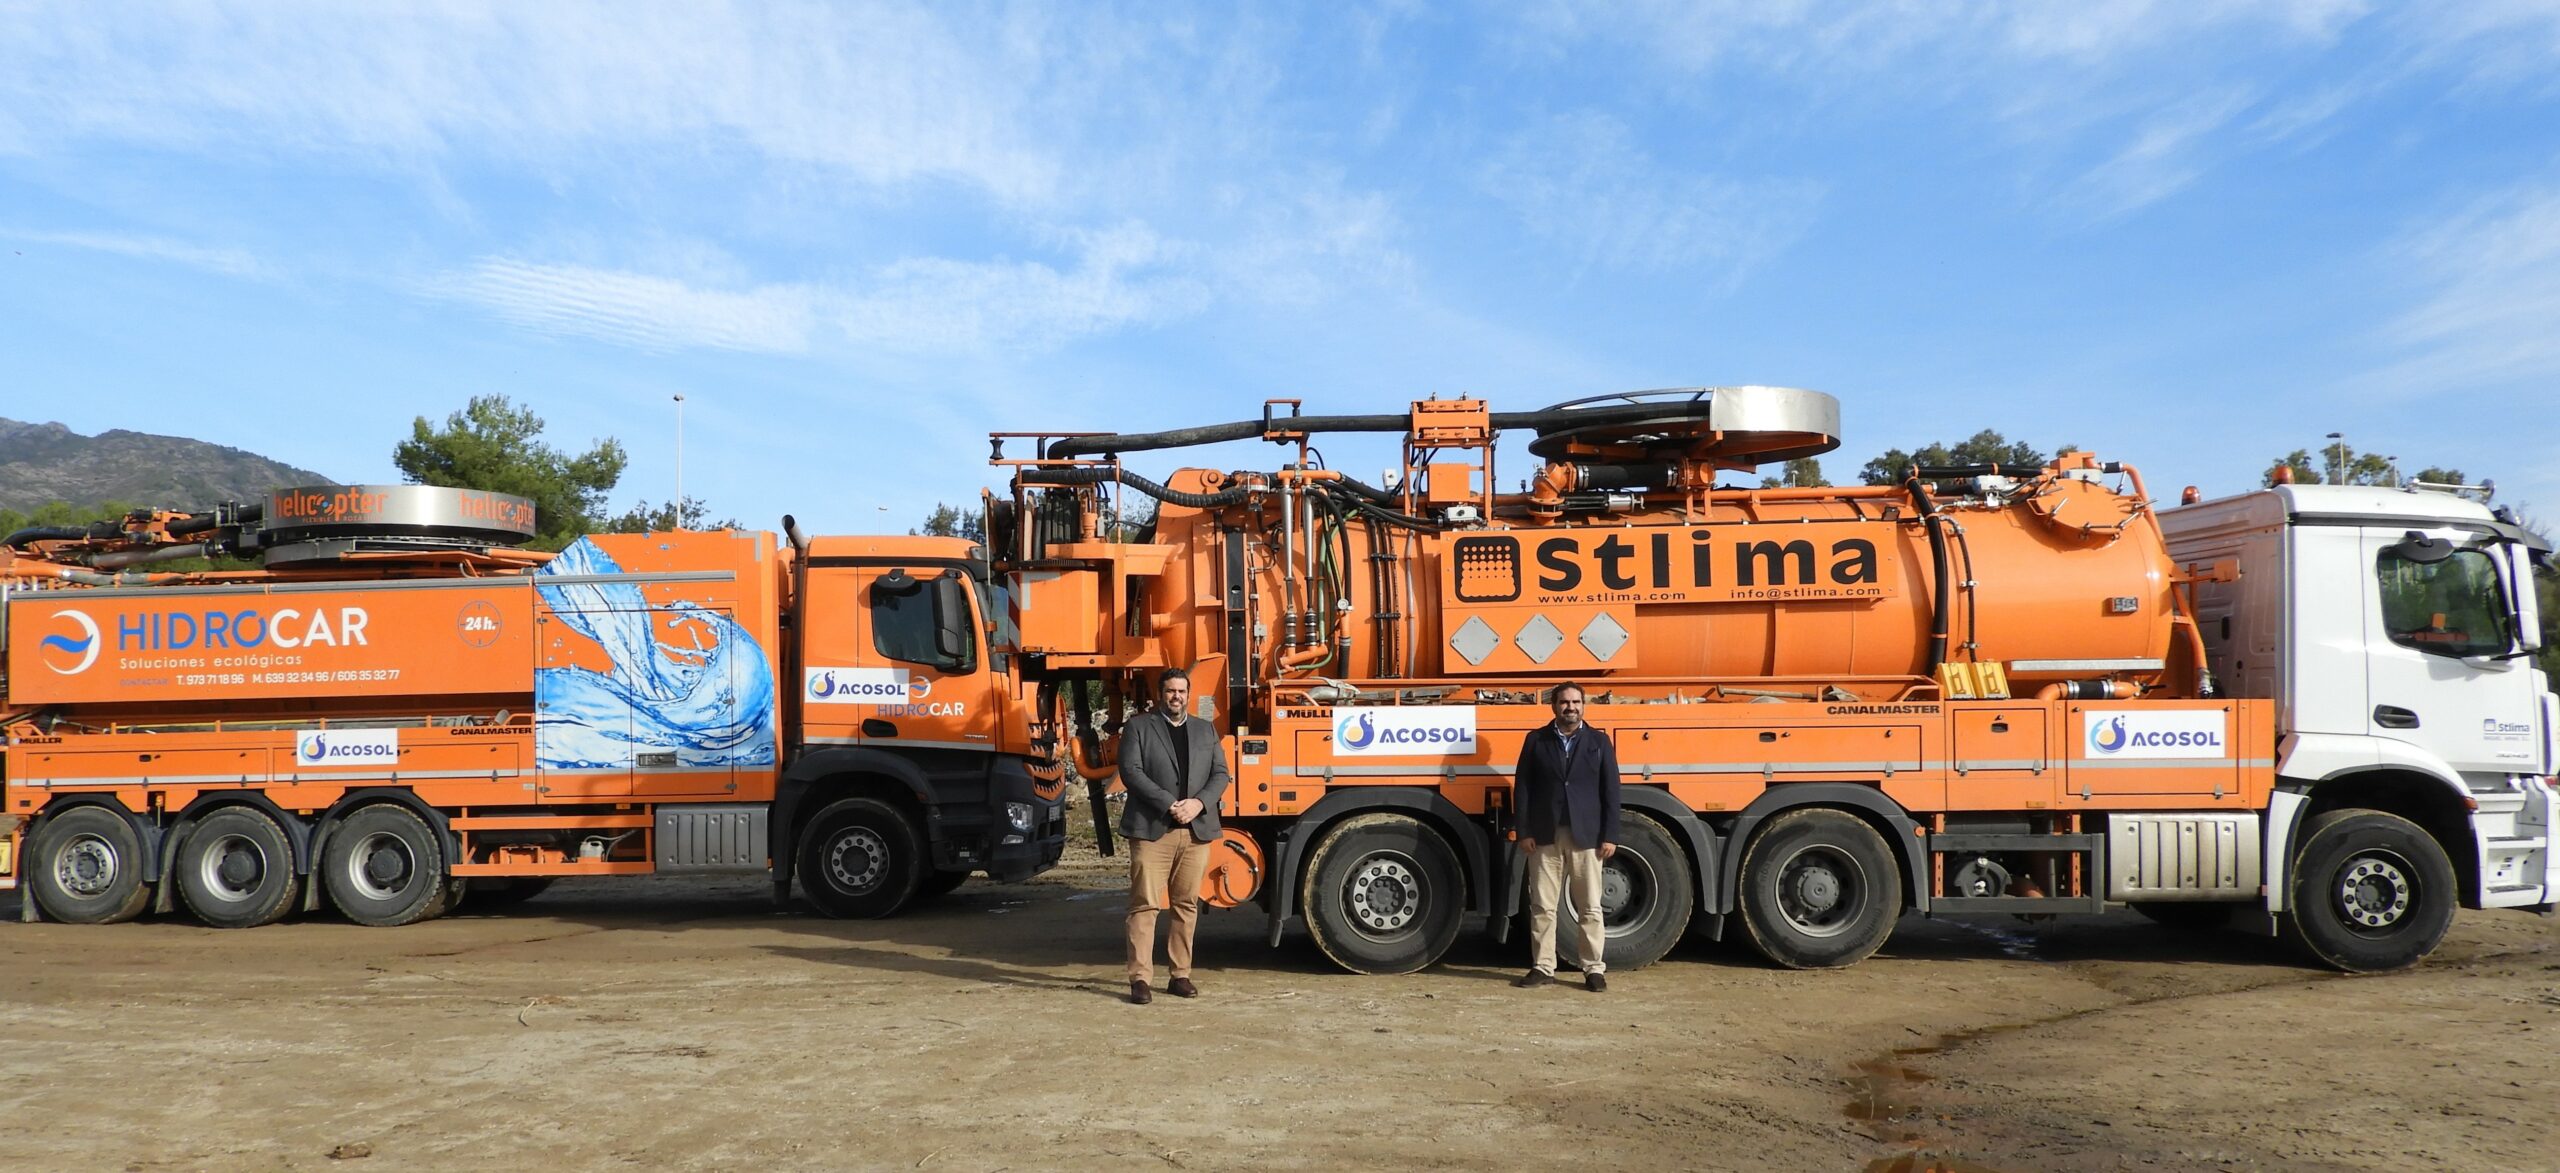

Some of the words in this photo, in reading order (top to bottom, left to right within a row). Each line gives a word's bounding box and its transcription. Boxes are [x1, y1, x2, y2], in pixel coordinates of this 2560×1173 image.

[459, 490, 535, 530] helicopte
[1538, 592, 1686, 603] www.stlima.com
[1731, 588, 1881, 600] info@stlima.com
[118, 607, 368, 651] HIDROCAR
[464, 616, 482, 631] 24
[119, 657, 206, 670] Soluciones
[213, 654, 302, 669] ecológicas
[186, 674, 205, 685] 973
[206, 674, 217, 684] 71
[218, 674, 230, 684] 18
[252, 673, 264, 684] M.
[265, 672, 285, 684] 639
[287, 672, 299, 683] 32
[301, 671, 314, 683] 34
[315, 671, 329, 682] 96
[337, 670, 357, 682] 606
[358, 670, 372, 681] 35
[373, 669, 387, 681] 32
[388, 669, 400, 680] 77
[838, 683, 906, 696] ACOSOL
[877, 702, 965, 718] HIDROCAR
[1287, 708, 1333, 718] MÜLL
[1826, 705, 1940, 715] CANALMASTER
[450, 727, 532, 735] CANALMASTER
[1379, 727, 1473, 744] ACOSOL
[2131, 731, 2220, 747] ACOSOL
[329, 744, 394, 757] ACOSOL
